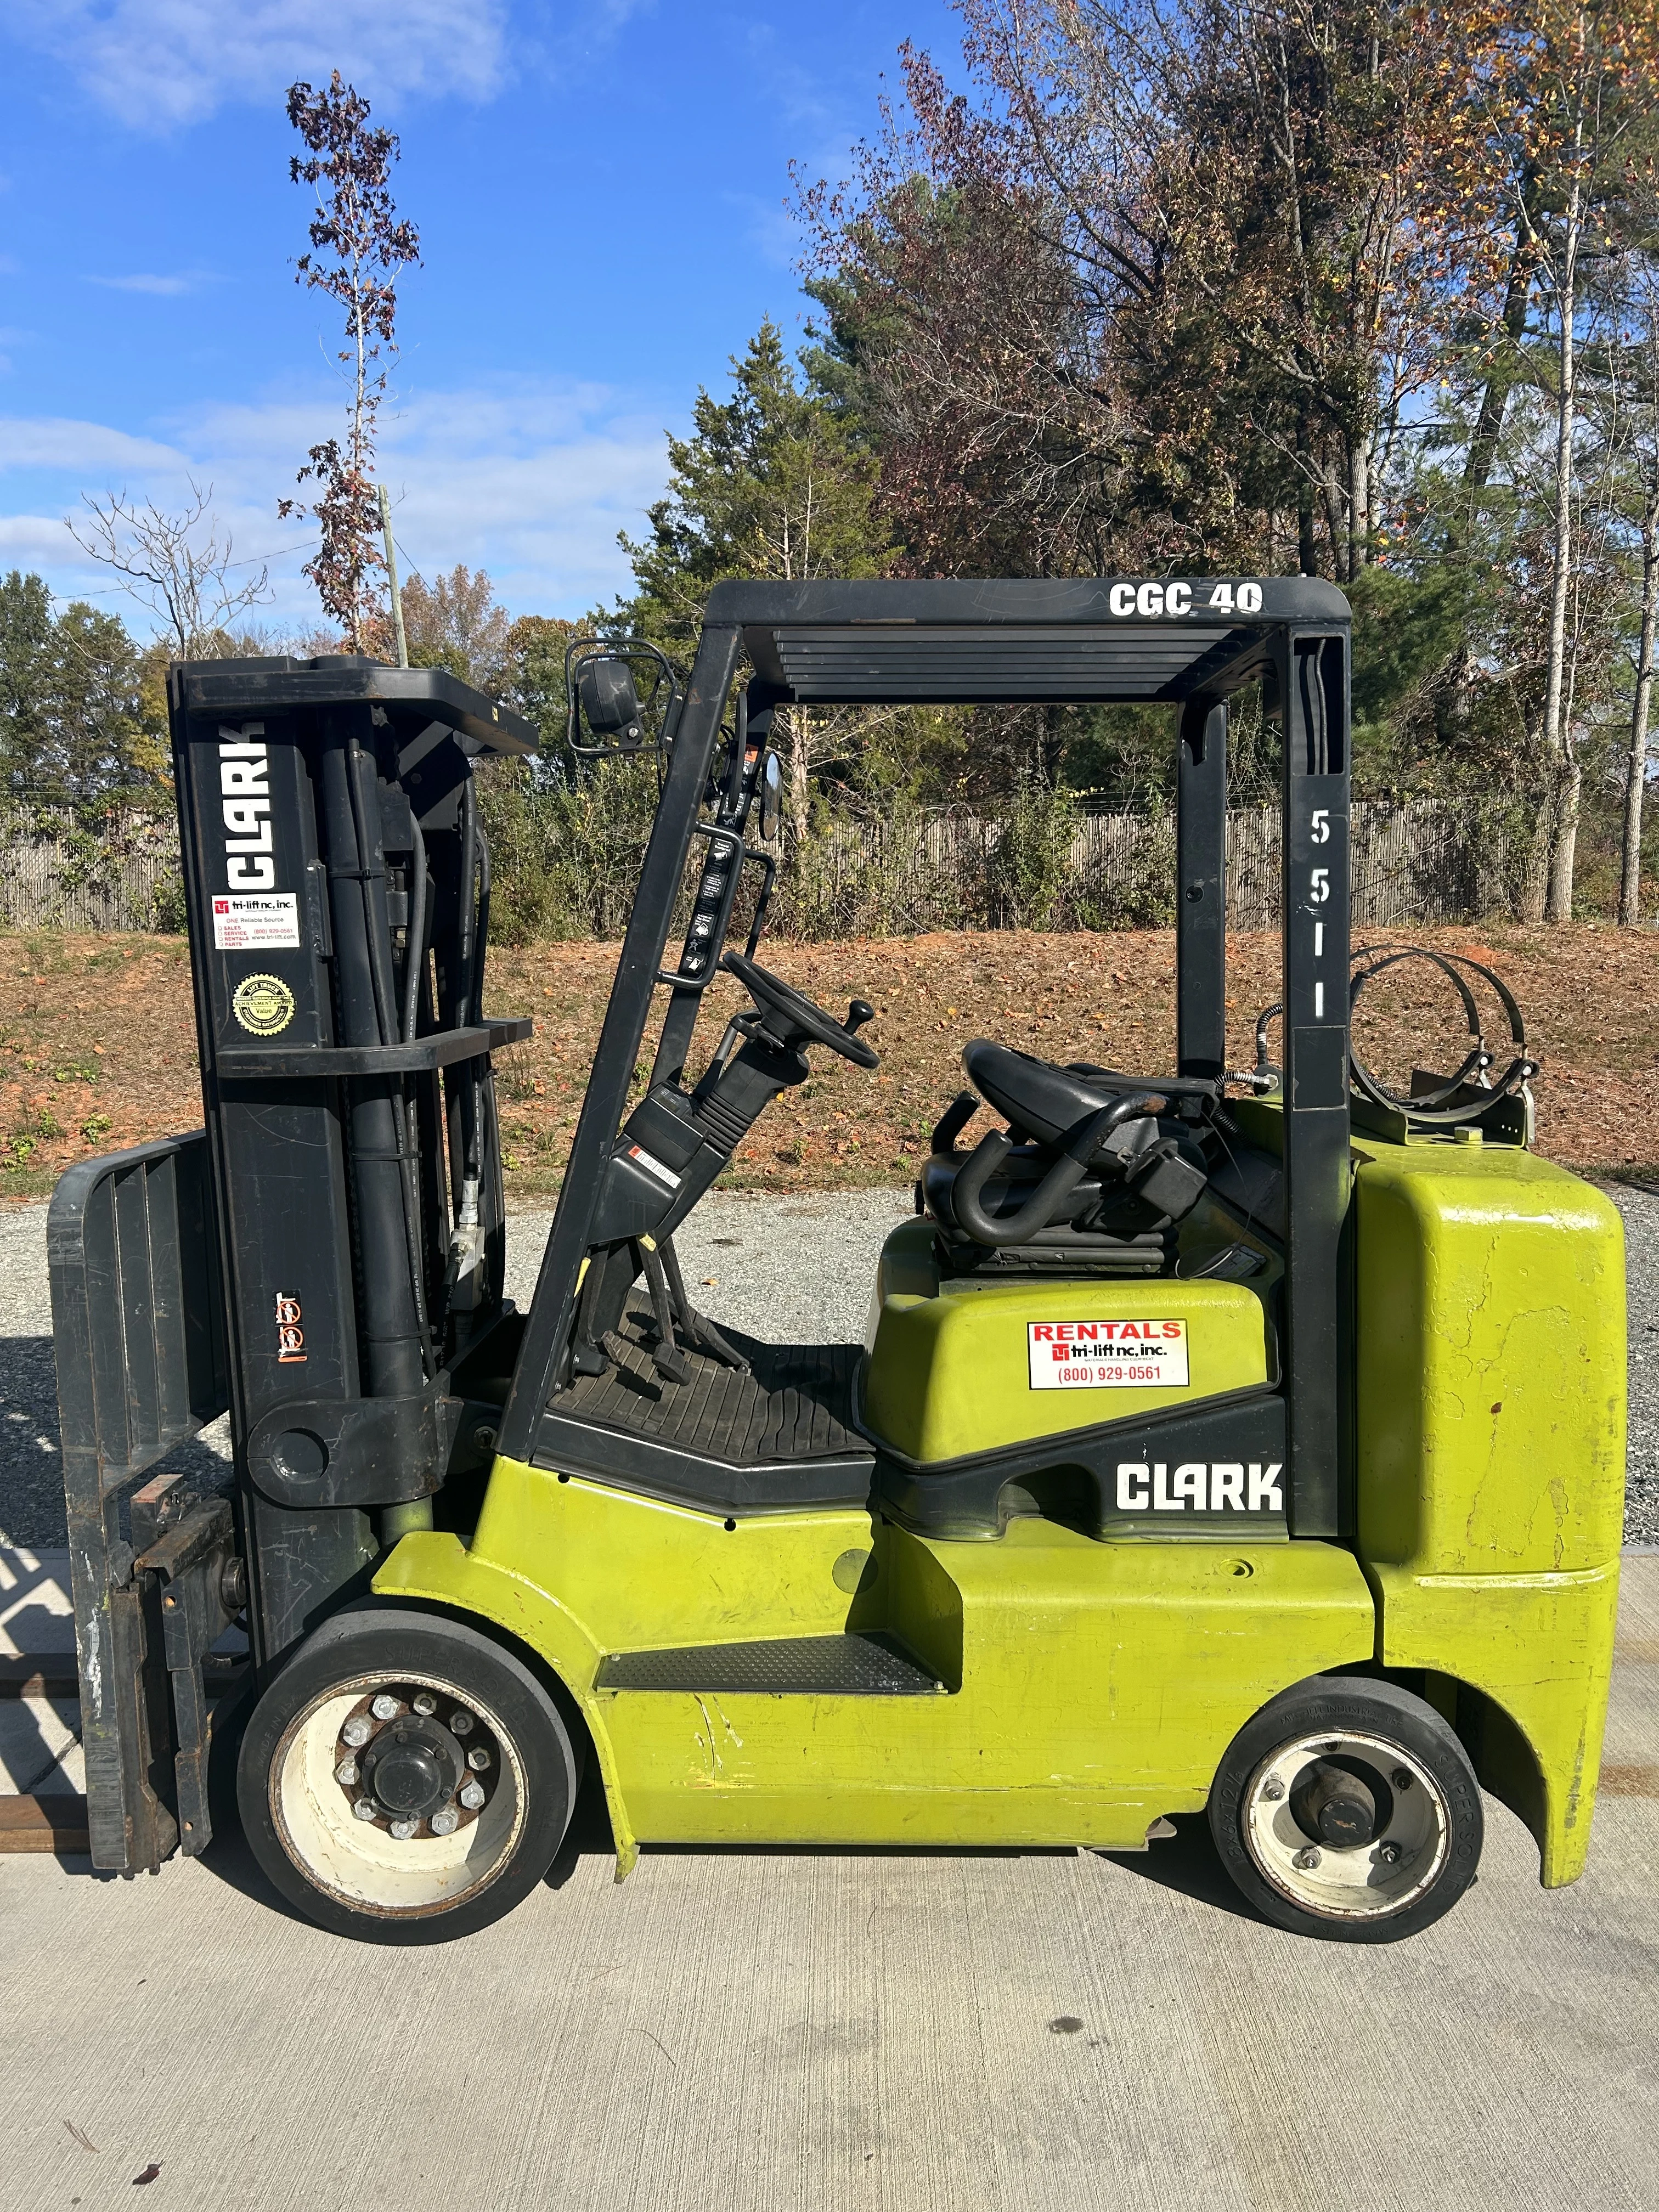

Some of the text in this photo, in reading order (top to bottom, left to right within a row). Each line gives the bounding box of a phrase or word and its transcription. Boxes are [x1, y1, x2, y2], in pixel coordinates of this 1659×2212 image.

[1109, 582, 1263, 617] CGC 40
[219, 721, 275, 890] CLARK
[232, 900, 259, 910] tri-lift
[276, 900, 294, 909] inc.
[259, 983, 279, 994] TRUCK
[1034, 1322, 1181, 1341] RENTALS
[1071, 1344, 1167, 1358] tri-lift nc, inc.
[1058, 1366, 1160, 1384] (800) 929-0561
[1116, 1463, 1283, 1511] CLARK
[1326, 1705, 1378, 1719] INDUSTRIA
[1434, 1755, 1475, 1824] SUPER
